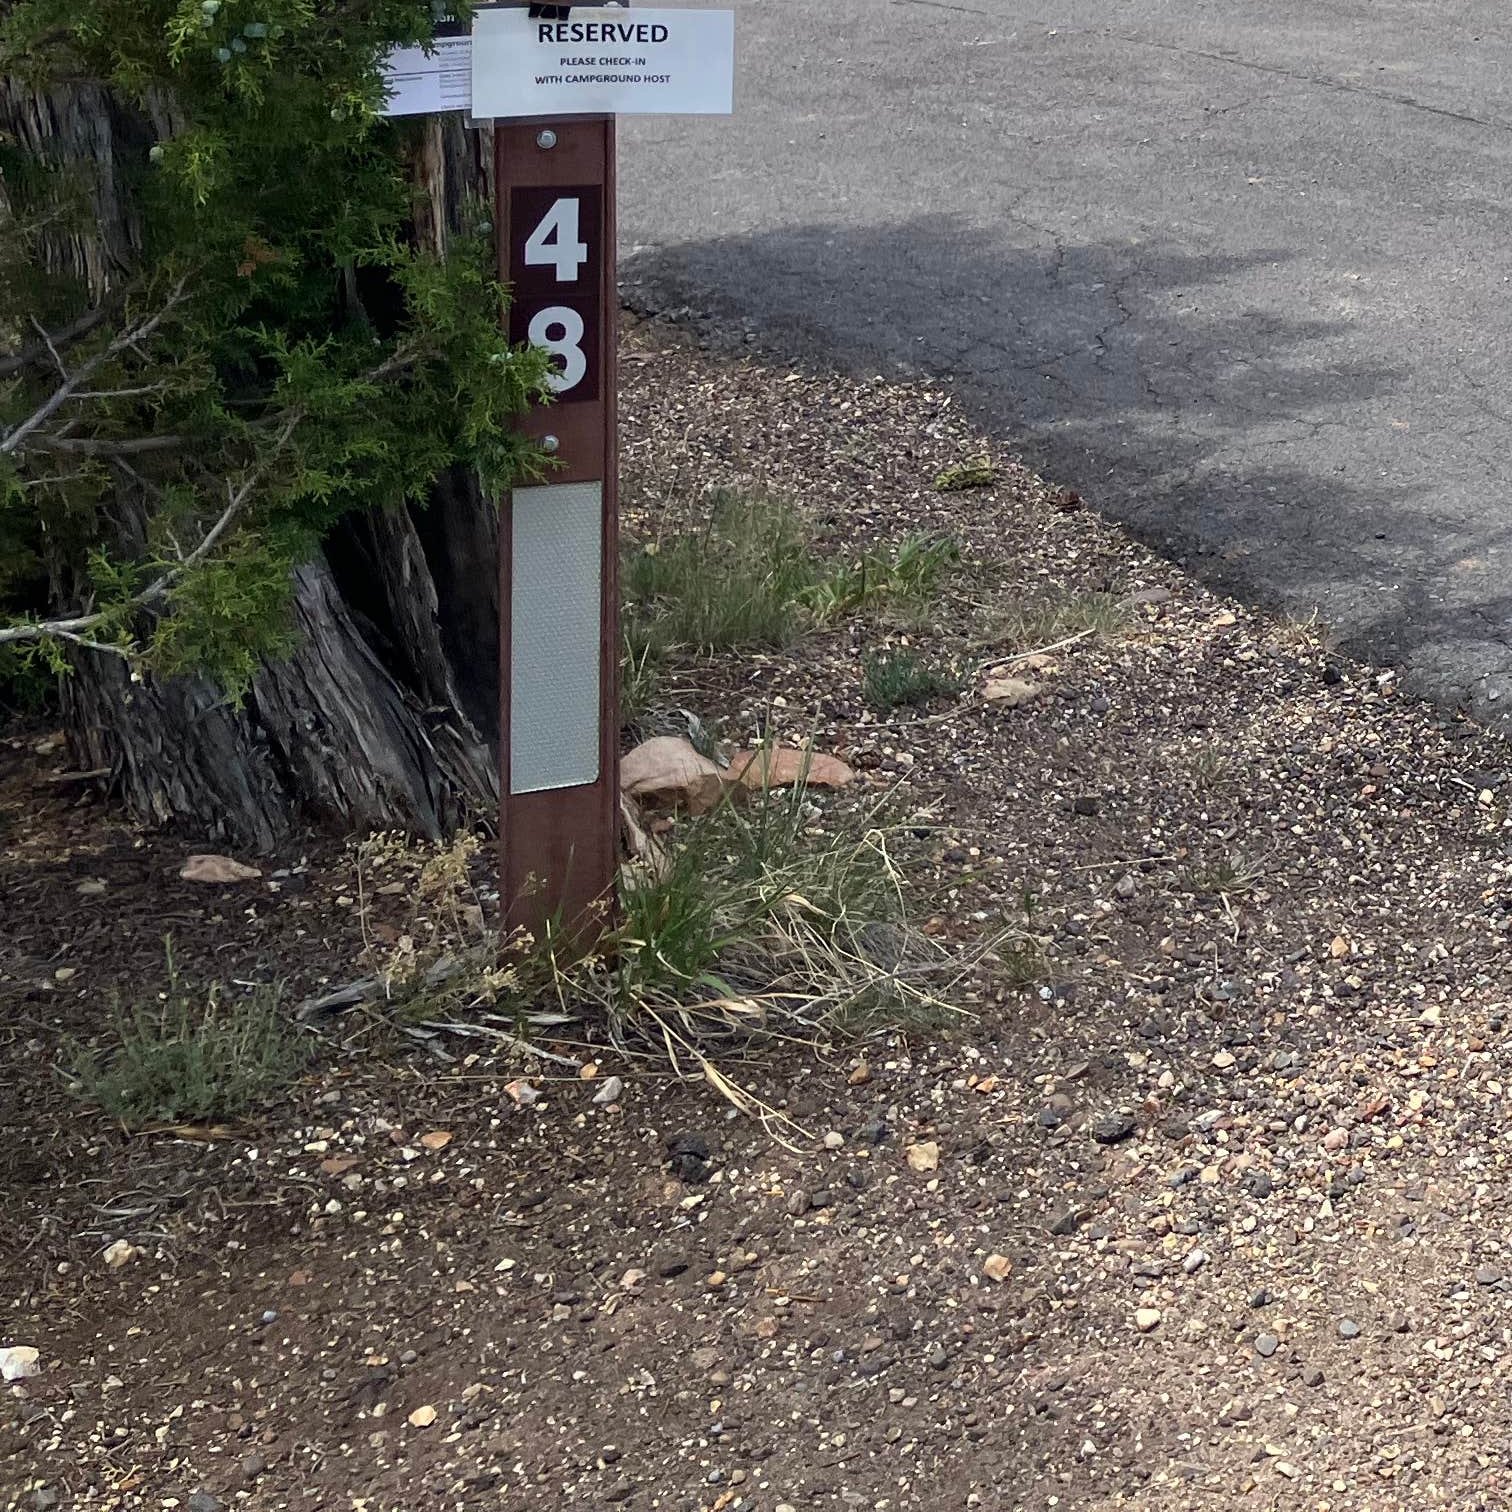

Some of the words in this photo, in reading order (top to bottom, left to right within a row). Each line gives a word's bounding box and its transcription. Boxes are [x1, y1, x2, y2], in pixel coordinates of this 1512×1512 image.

[538, 23, 669, 43] RESERVED
[560, 57, 596, 66] PLEASE
[599, 57, 646, 66] CHECK-IN
[535, 75, 563, 84] WITH
[565, 74, 641, 84] CAMPGROUND
[643, 74, 671, 83] HOST
